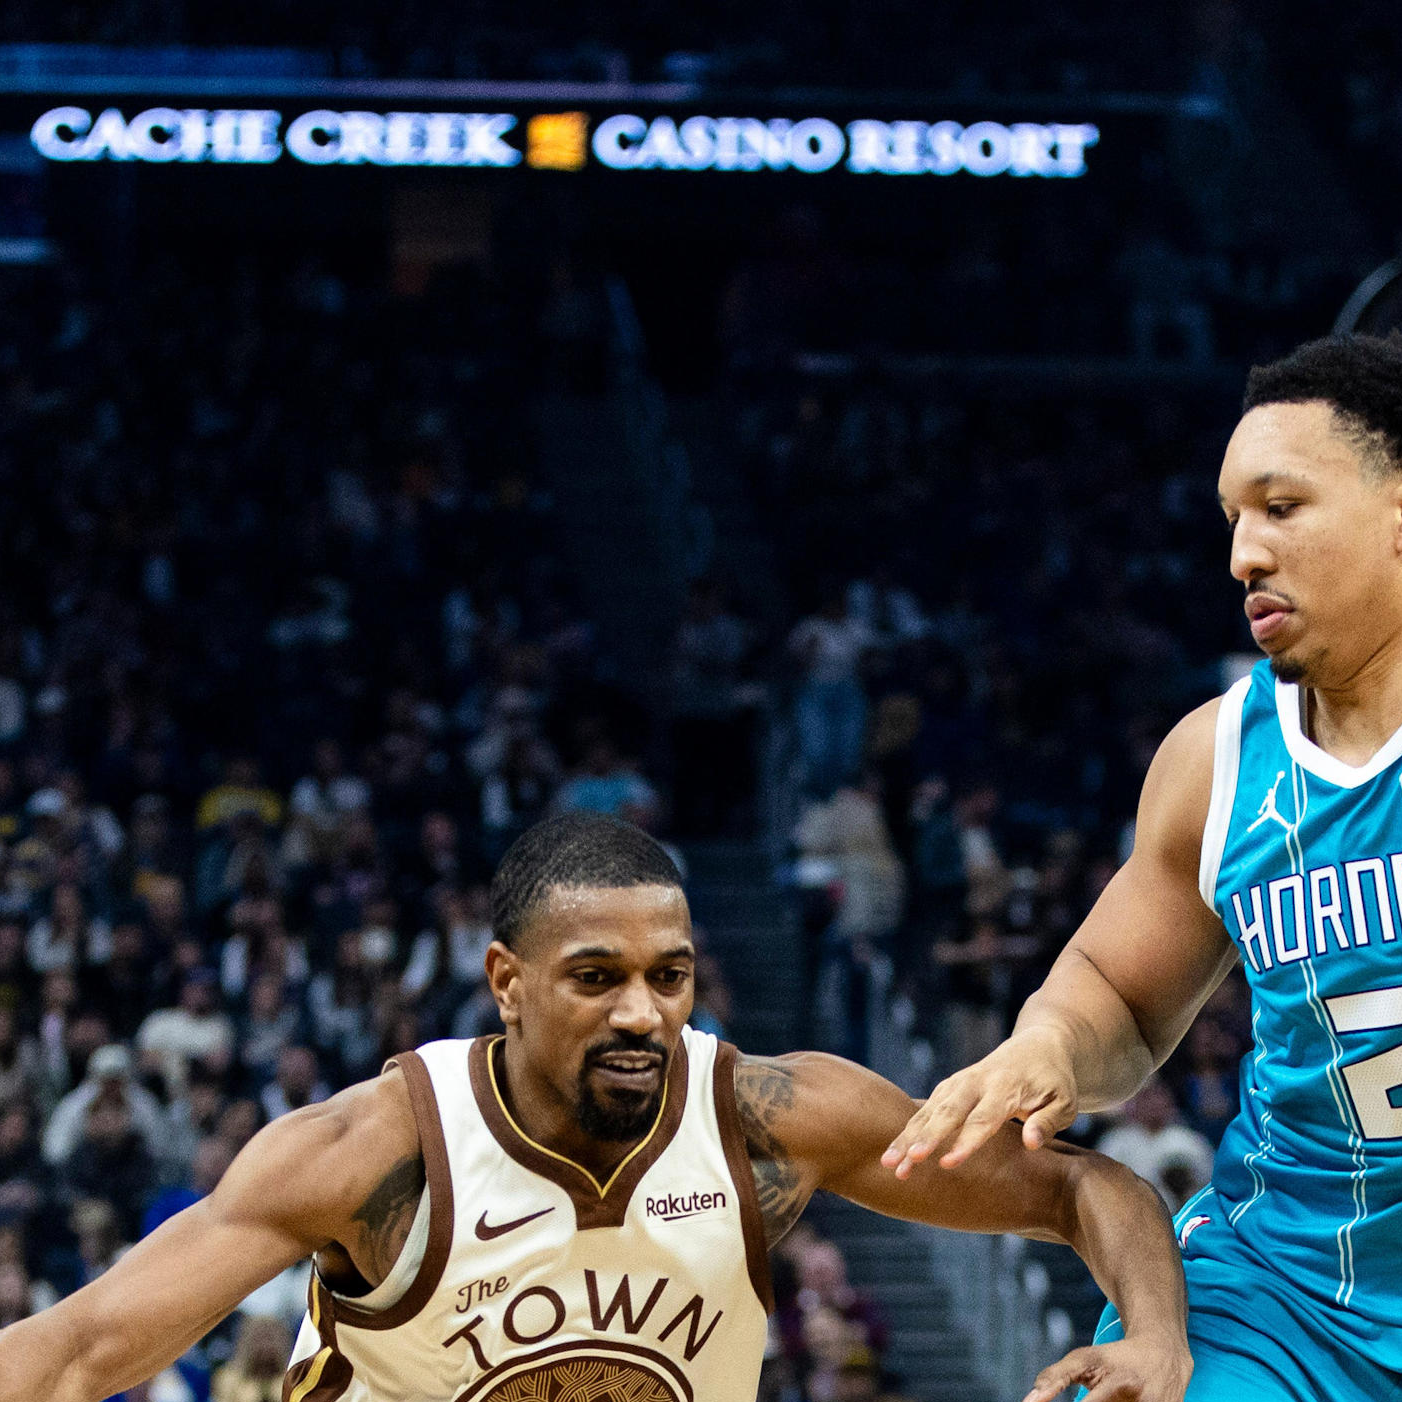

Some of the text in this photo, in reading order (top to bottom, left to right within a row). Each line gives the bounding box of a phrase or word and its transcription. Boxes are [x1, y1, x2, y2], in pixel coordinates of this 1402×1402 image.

[30, 106, 1100, 178] CACHE CREEK CASINO RESORT
[646, 1191, 727, 1217] Rakuten
[442, 1269, 724, 1372] TOWN
[454, 1273, 511, 1315] The
